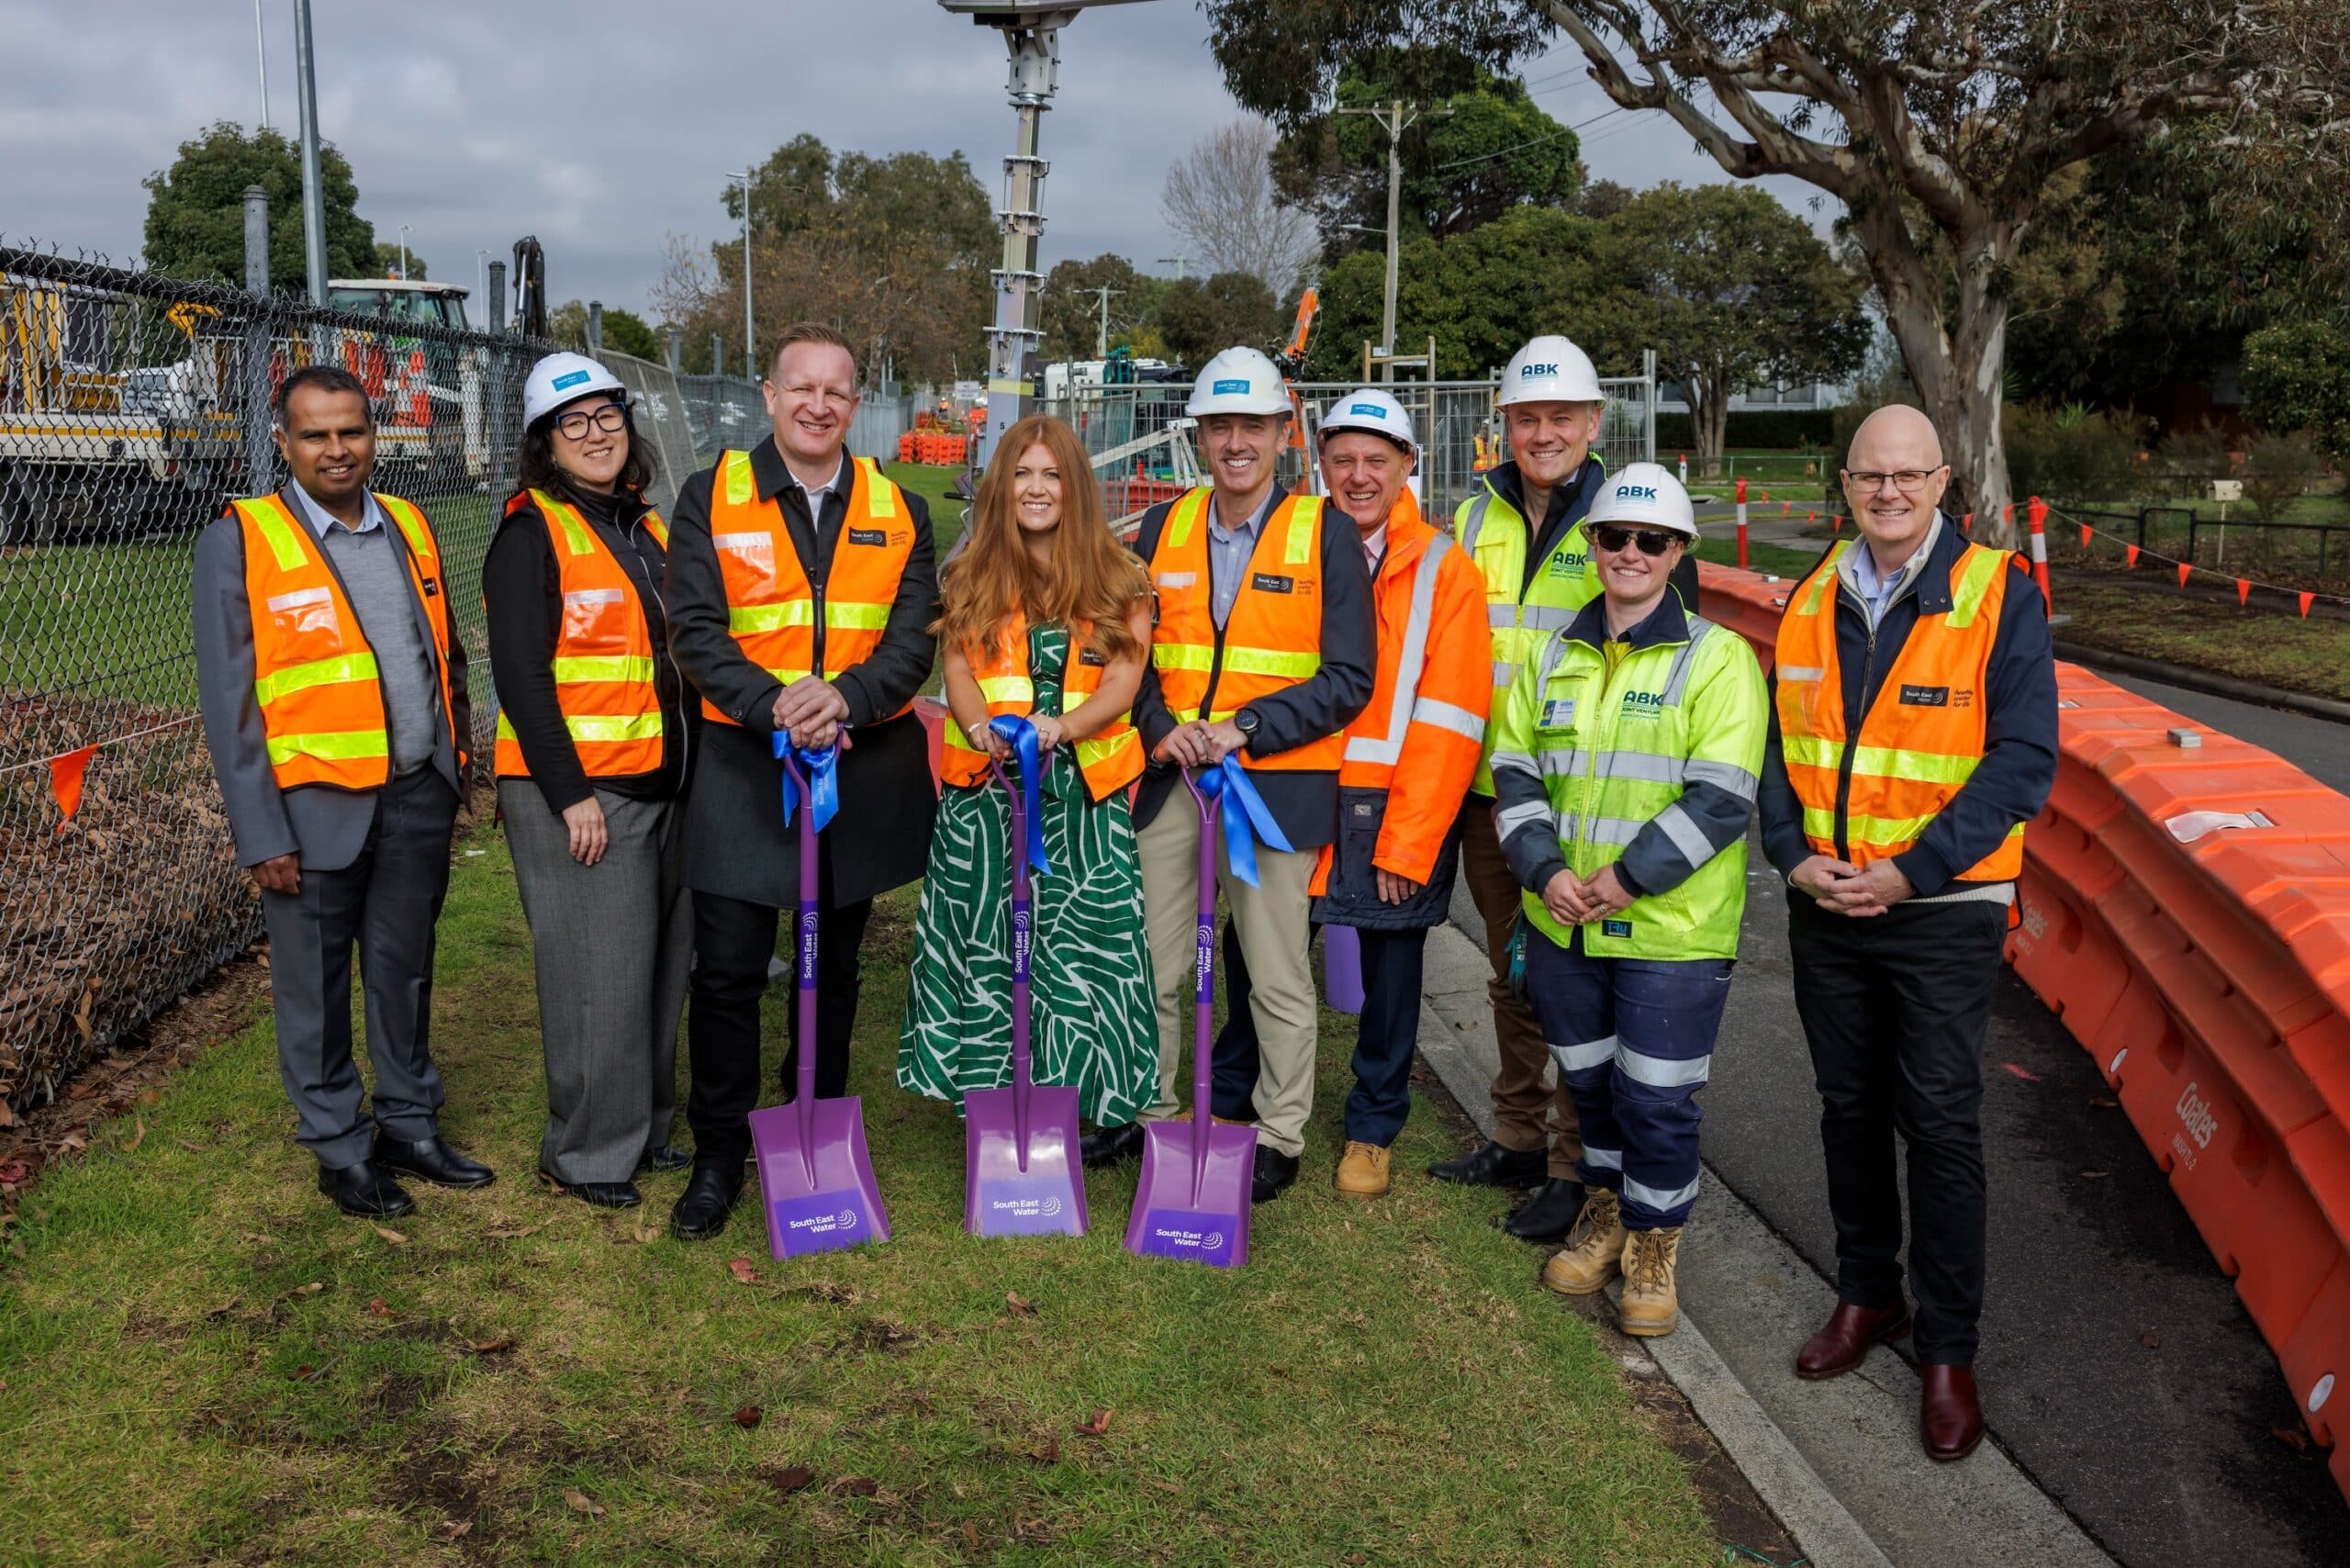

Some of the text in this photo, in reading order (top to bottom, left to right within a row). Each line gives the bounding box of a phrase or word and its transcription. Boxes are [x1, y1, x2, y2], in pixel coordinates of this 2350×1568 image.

[1521, 364, 1559, 376] ABK
[1616, 486, 1658, 498] ABK
[1552, 552, 1586, 566] ABK
[1623, 690, 1665, 706] ABK
[804, 933, 812, 980] South East
[1014, 930, 1024, 974] South East
[1196, 946, 1204, 966] East
[1203, 946, 1212, 974] Water
[2176, 1081, 2219, 1149] Coates
[993, 1198, 1039, 1209] South East
[1013, 1207, 1039, 1216] Water
[789, 1214, 835, 1228] South East
[810, 1223, 836, 1233] Water
[1156, 1228, 1203, 1239] South East
[1174, 1238, 1202, 1247] Water
